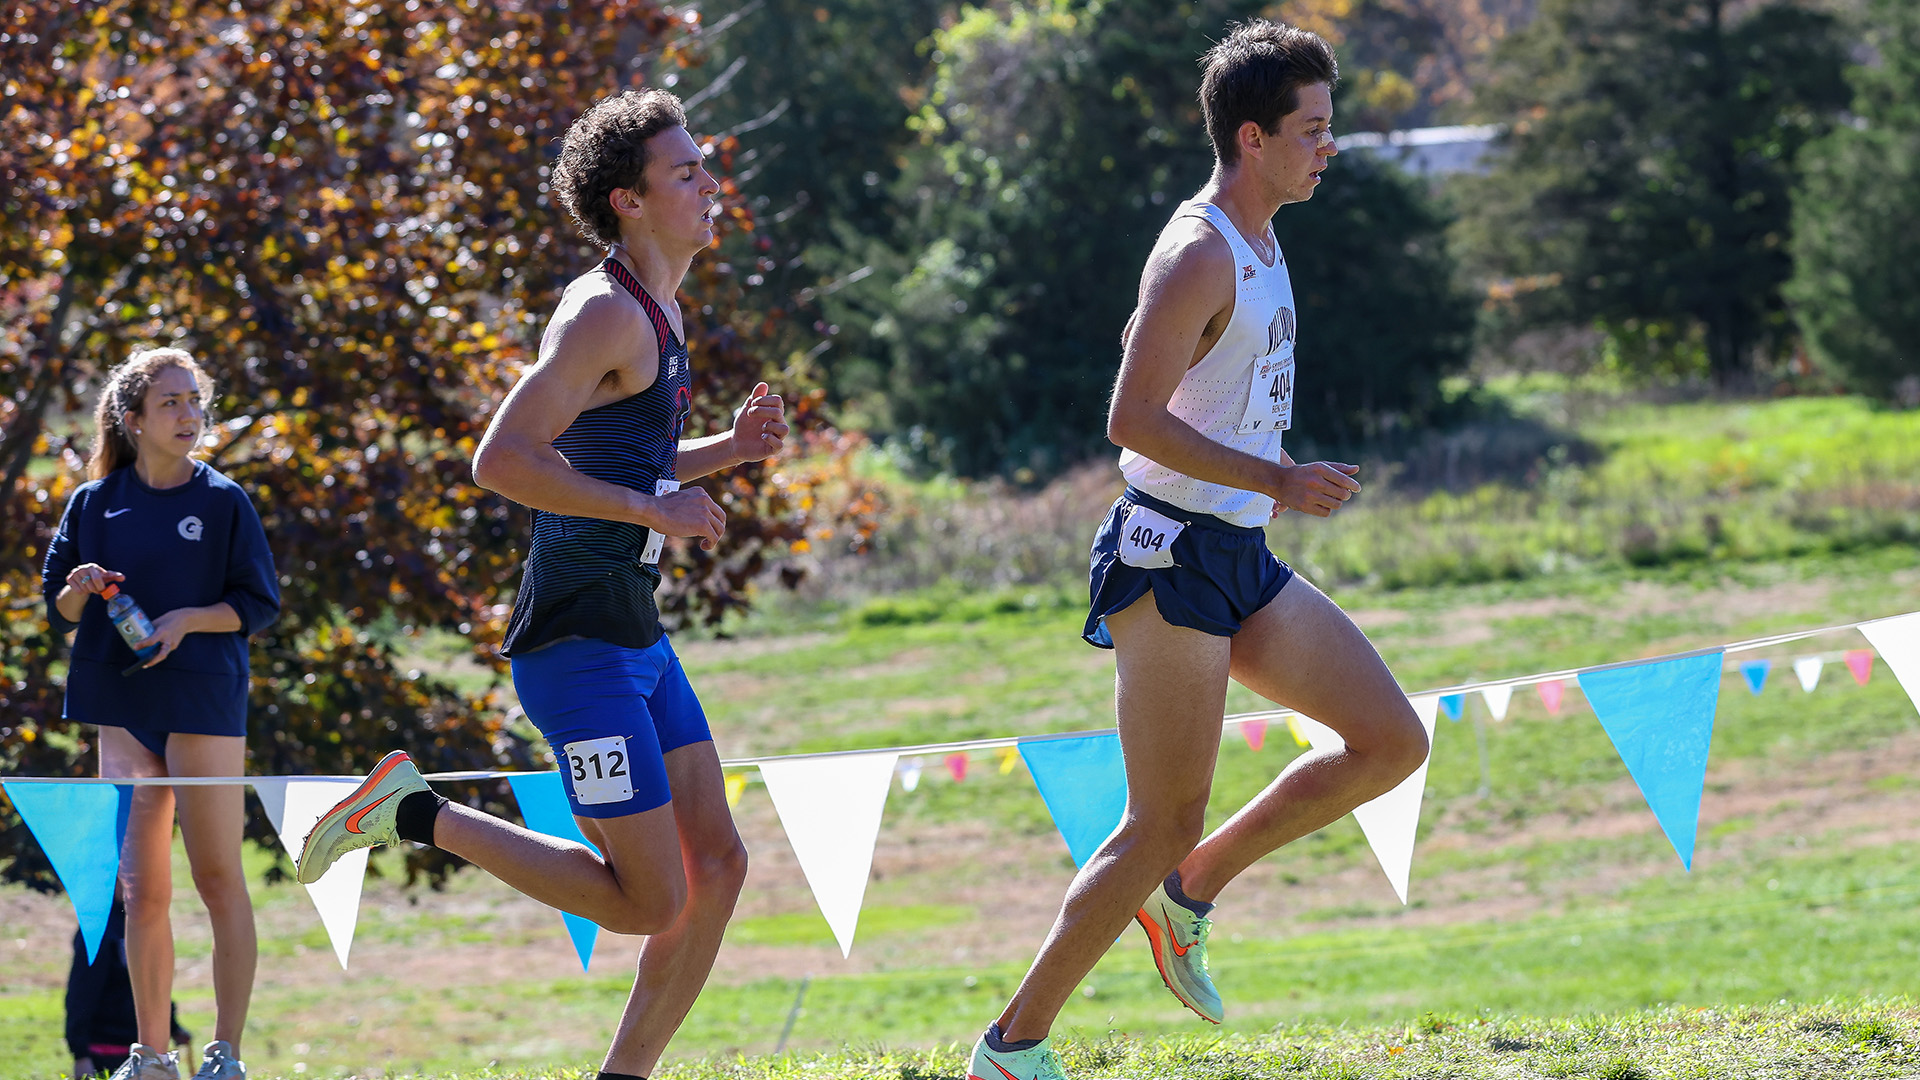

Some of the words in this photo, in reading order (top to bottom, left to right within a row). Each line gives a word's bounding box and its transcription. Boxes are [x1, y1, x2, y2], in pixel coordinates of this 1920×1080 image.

[668, 365, 679, 375] EAS
[669, 355, 679, 366] BIG
[1269, 370, 1291, 403] 404
[177, 515, 204, 541] G
[1130, 525, 1165, 552] 404
[570, 750, 627, 781] 312
